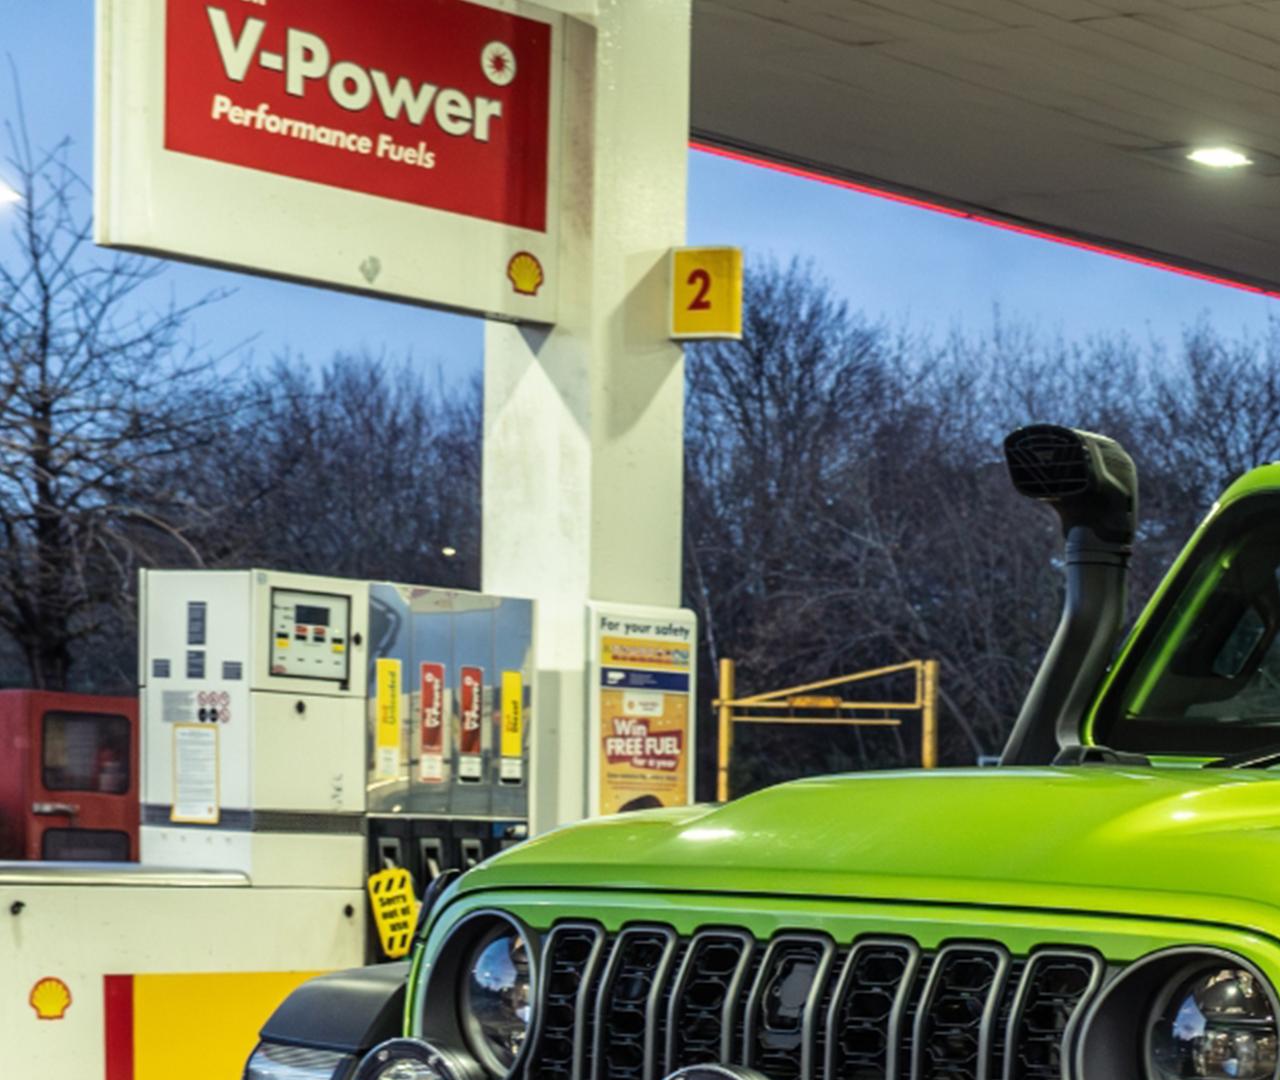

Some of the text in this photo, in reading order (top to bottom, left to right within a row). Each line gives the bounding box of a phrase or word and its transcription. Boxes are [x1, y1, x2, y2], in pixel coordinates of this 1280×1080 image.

[207, 6, 503, 142] V-Power
[211, 95, 436, 169] Performance Fuels
[687, 268, 711, 311] 2
[600, 617, 690, 641] For your safety
[613, 718, 648, 737] Win
[606, 735, 682, 757] FREE FUEL
[379, 894, 407, 907] Sorry
